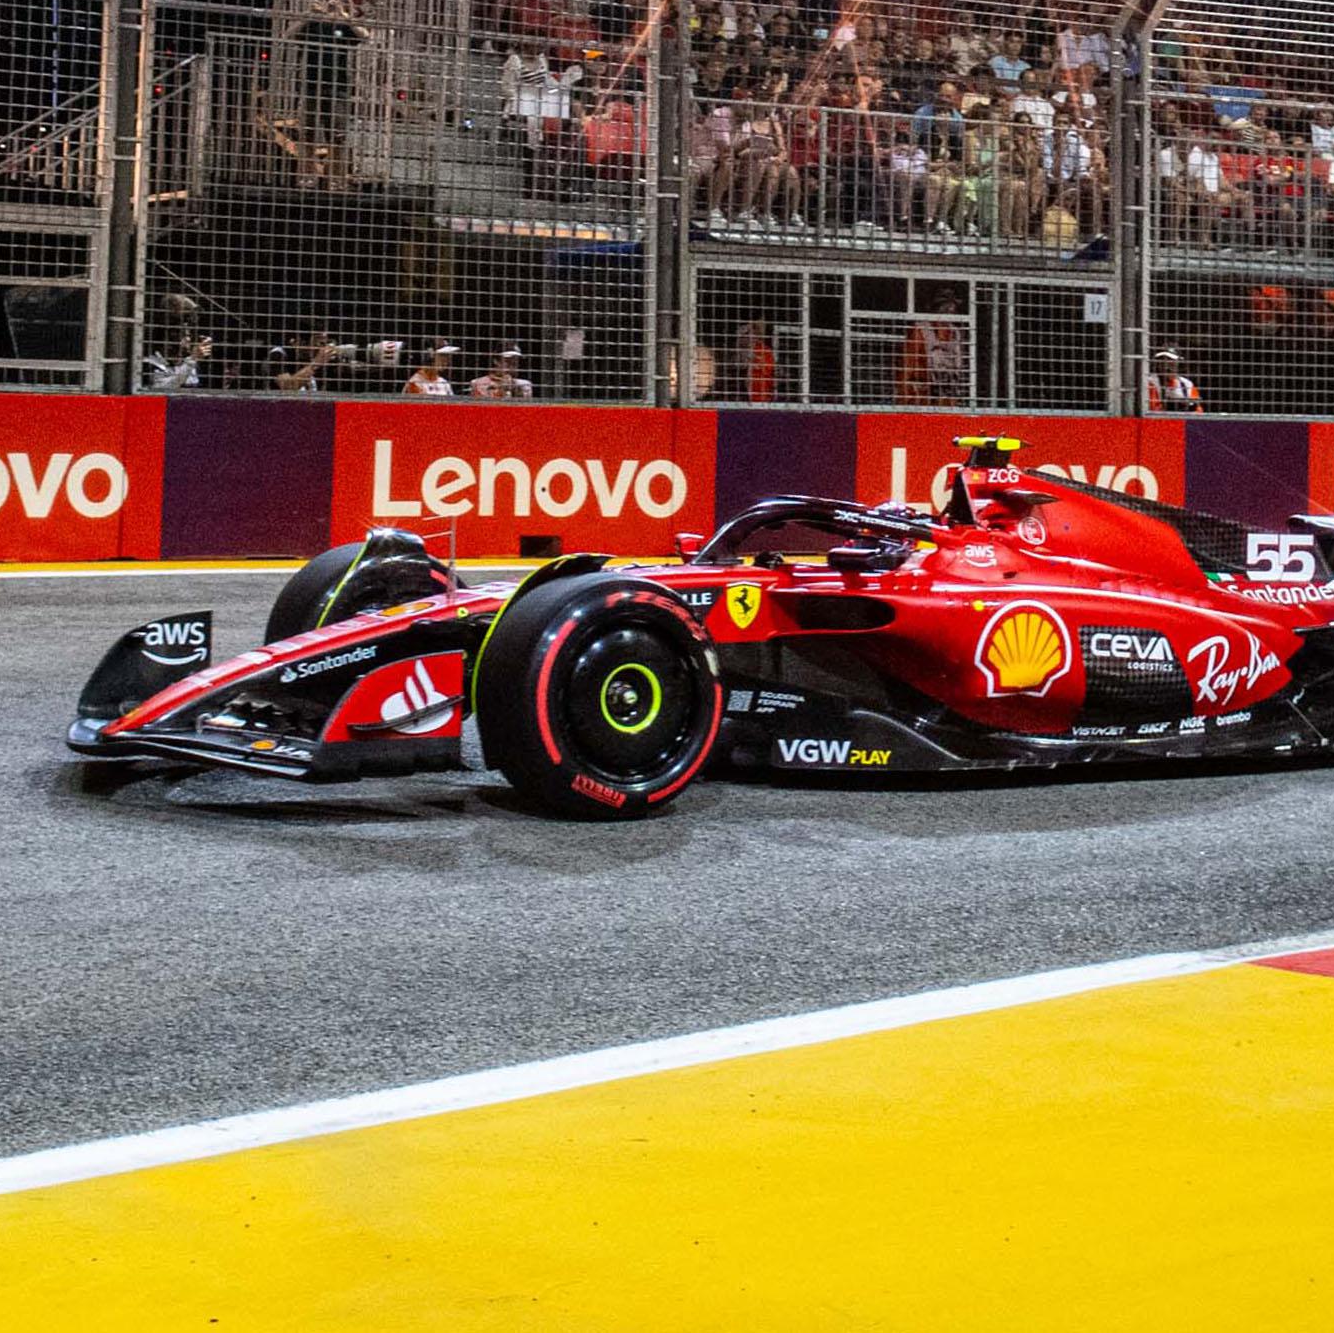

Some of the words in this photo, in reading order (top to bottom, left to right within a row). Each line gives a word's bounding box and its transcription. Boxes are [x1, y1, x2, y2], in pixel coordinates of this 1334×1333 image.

[1090, 300, 1103, 316] 17
[372, 439, 688, 519] Lenovo
[987, 467, 1020, 484] ZCG
[964, 544, 995, 558] aws
[1246, 532, 1316, 582] 55
[144, 621, 206, 646] aws
[296, 645, 379, 678] Santander
[1127, 661, 1174, 673] LOGISTICS
[1179, 714, 1207, 729] NGK
[1216, 711, 1252, 727] brembo
[1137, 721, 1171, 734] SKF
